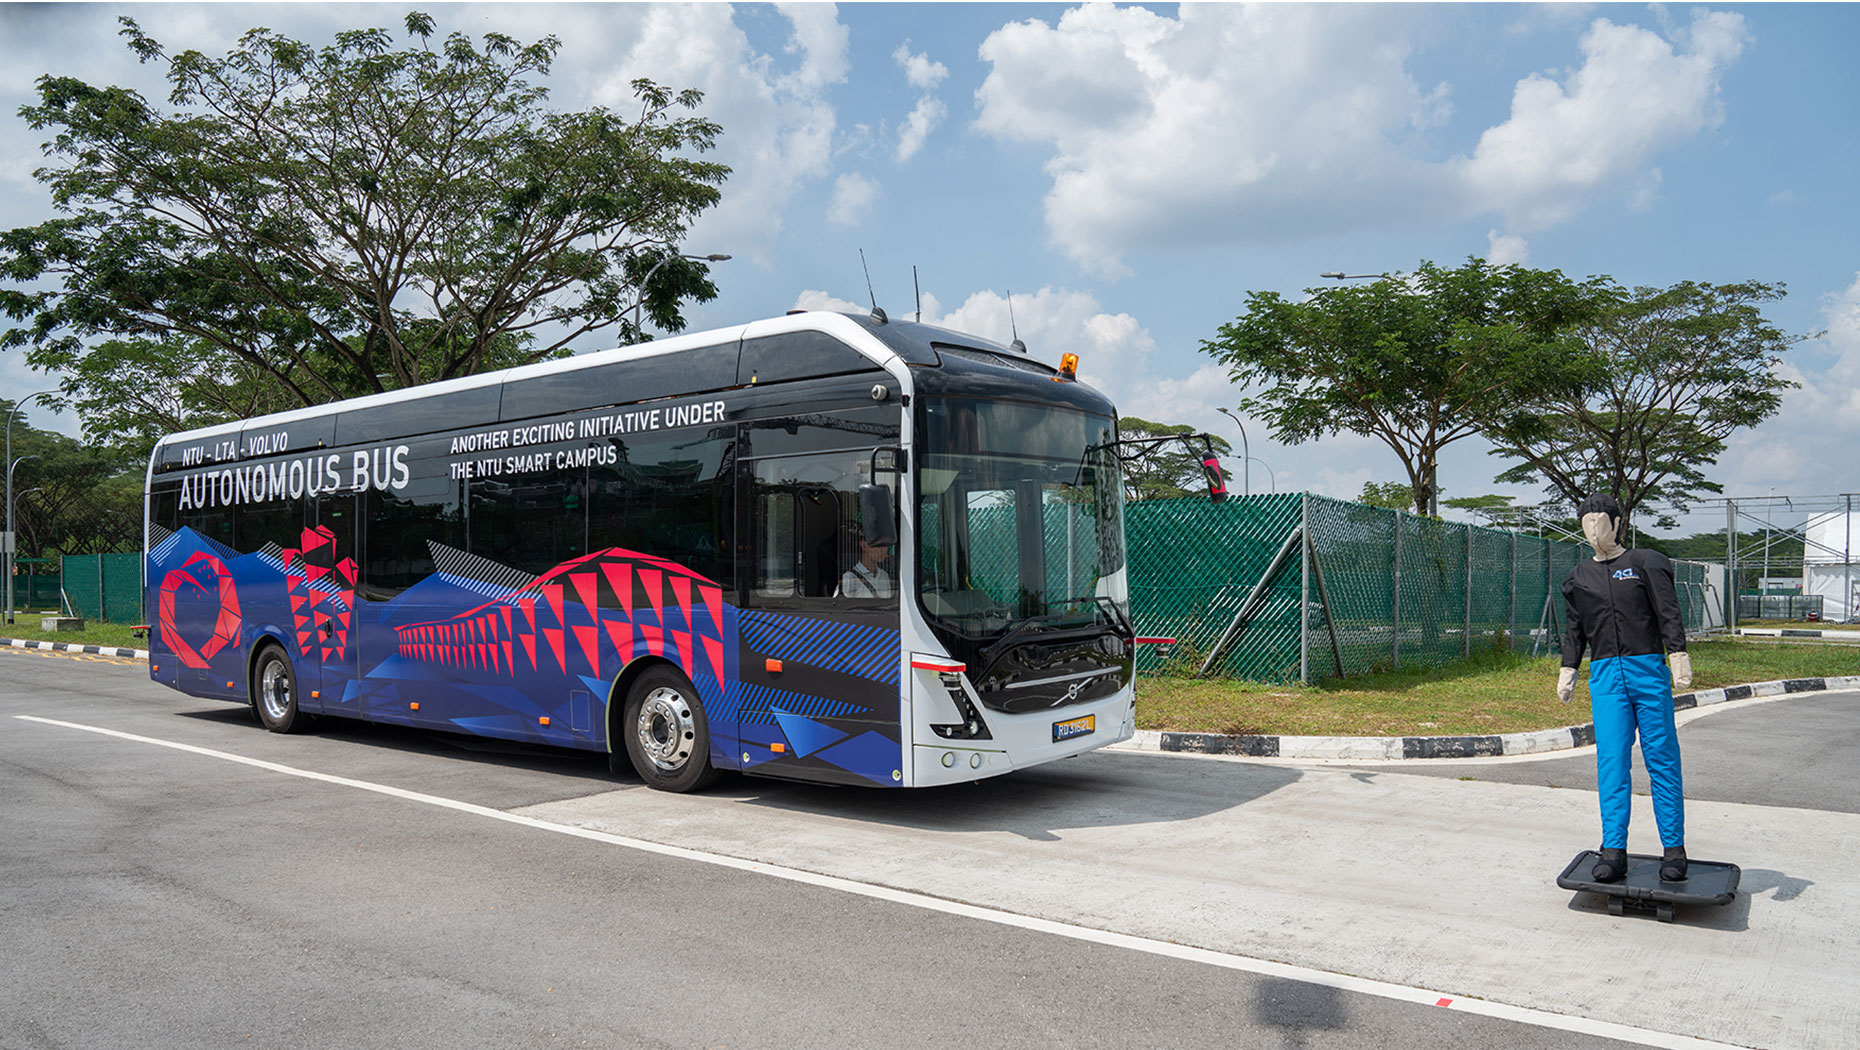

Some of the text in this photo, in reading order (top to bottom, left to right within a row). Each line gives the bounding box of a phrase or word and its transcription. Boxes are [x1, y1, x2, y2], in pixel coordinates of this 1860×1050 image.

[182, 446, 204, 467] NTU
[214, 441, 236, 461] LTA
[249, 431, 288, 456] VOLVO
[450, 400, 726, 454] ANOTHER EXCITING INITIATIVE UNDER
[178, 445, 409, 511] AUTONOMOUS BUS
[450, 445, 617, 480] THE NTU SMART CAMPUS
